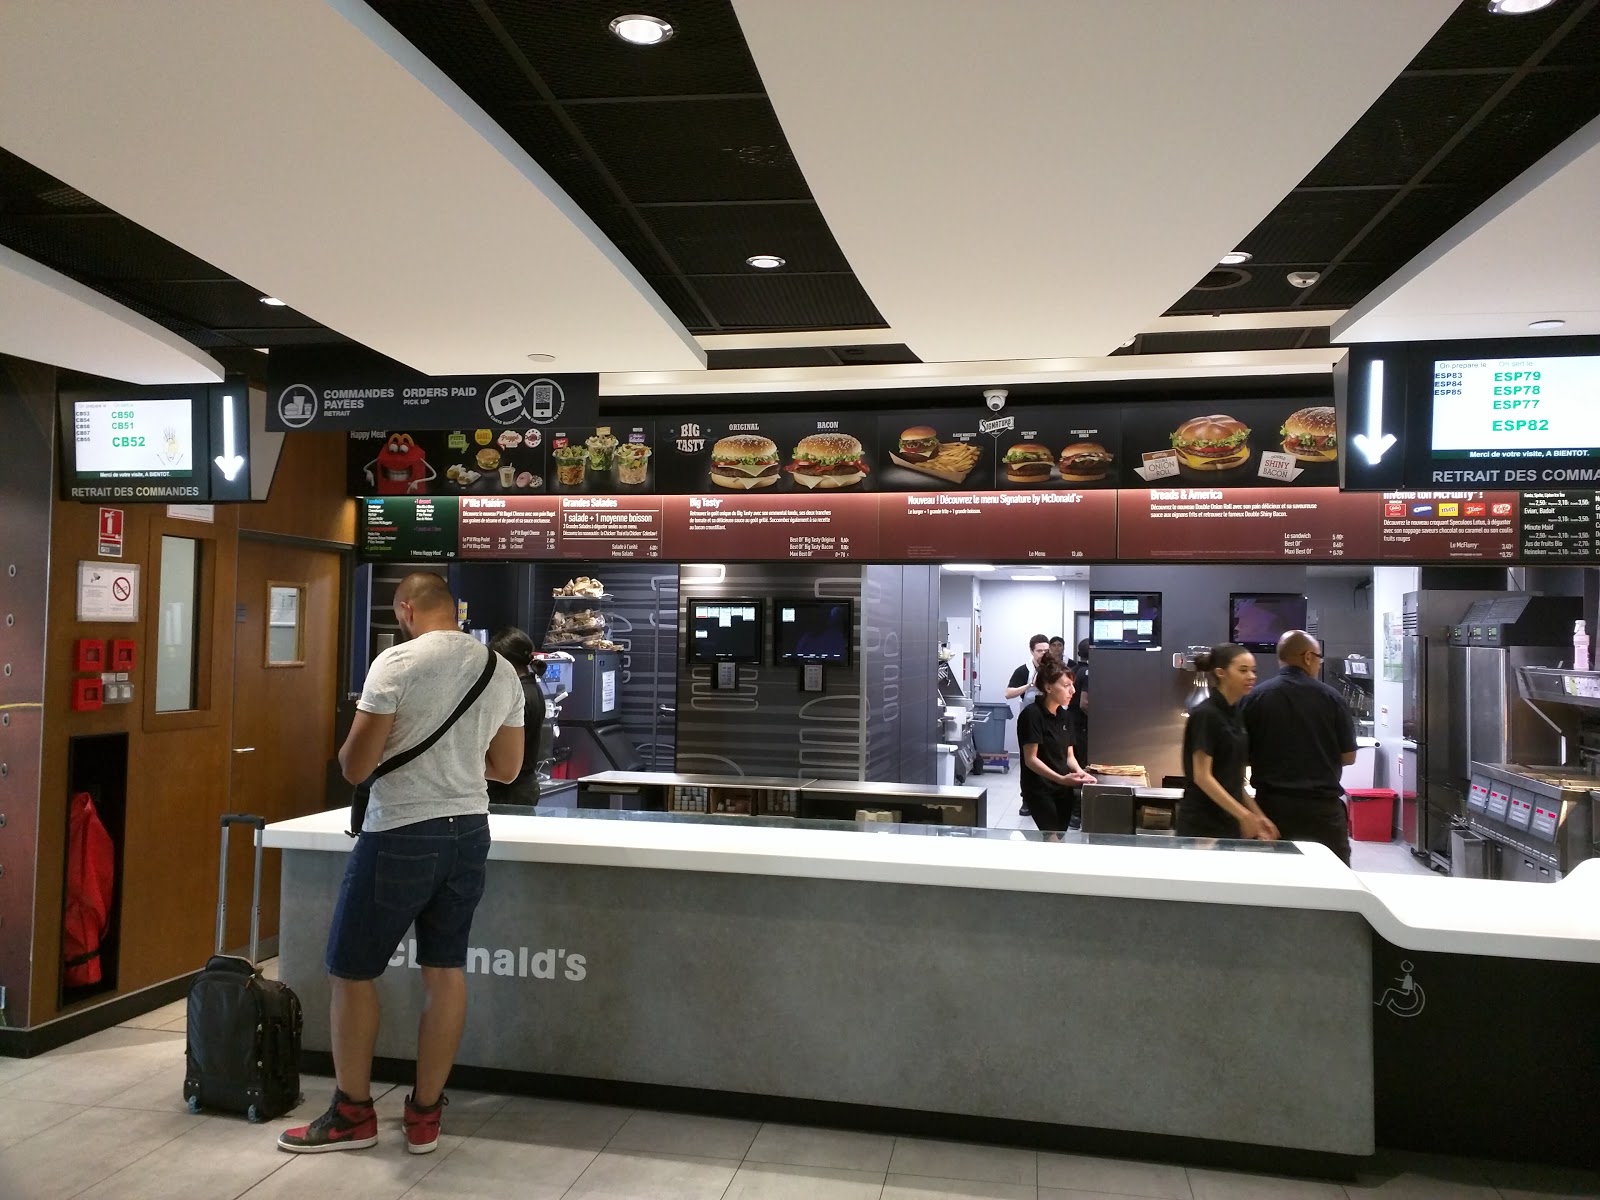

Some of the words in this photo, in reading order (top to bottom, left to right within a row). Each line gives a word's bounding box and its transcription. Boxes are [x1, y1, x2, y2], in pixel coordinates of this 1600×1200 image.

[1494, 371, 1541, 382] ESP79
[323, 388, 395, 399] COMMANDES
[402, 387, 449, 398] ORDERS
[451, 387, 477, 397] PAID
[1493, 385, 1540, 396] ESP78
[1493, 400, 1540, 410] ESP77
[111, 411, 134, 419] CB50
[111, 422, 134, 430] CB51
[681, 423, 700, 437] BIG
[729, 423, 760, 431] ORIGINAL
[817, 421, 839, 429] BACON
[1492, 420, 1549, 431] ESP82
[350, 431, 370, 440] Happy
[371, 430, 384, 438] Meal
[112, 436, 146, 448] CB52
[676, 439, 705, 453] TASTY
[1148, 461, 1175, 472] ONION
[1264, 459, 1290, 469] SHINY
[1156, 469, 1171, 477] ROLL
[1262, 468, 1288, 478] BACON
[1432, 470, 1500, 483] RETRAIT
[1504, 469, 1537, 482] DES
[72, 488, 112, 497] RETRAIT
[114, 487, 133, 497] DES
[135, 487, 199, 496] COMMANDES
[1150, 489, 1180, 500] Breads
[1180, 489, 1187, 500] &
[1188, 489, 1223, 500] America
[563, 498, 591, 508] Grandes
[591, 498, 618, 508] Salades
[690, 497, 702, 509] Big
[702, 497, 719, 509] Tasty
[908, 496, 935, 505] Nouveau
[940, 494, 972, 504] Découvrez
[973, 494, 980, 504] le
[981, 496, 999, 504] menu
[1000, 494, 1032, 506] Signature
[1032, 493, 1041, 505] by
[564, 513, 567, 522] 1
[568, 513, 588, 522] salade
[596, 513, 599, 522] 1
[600, 515, 628, 525] moyenne
[628, 513, 652, 522] boisson
[387, 938, 587, 982] cnald's
